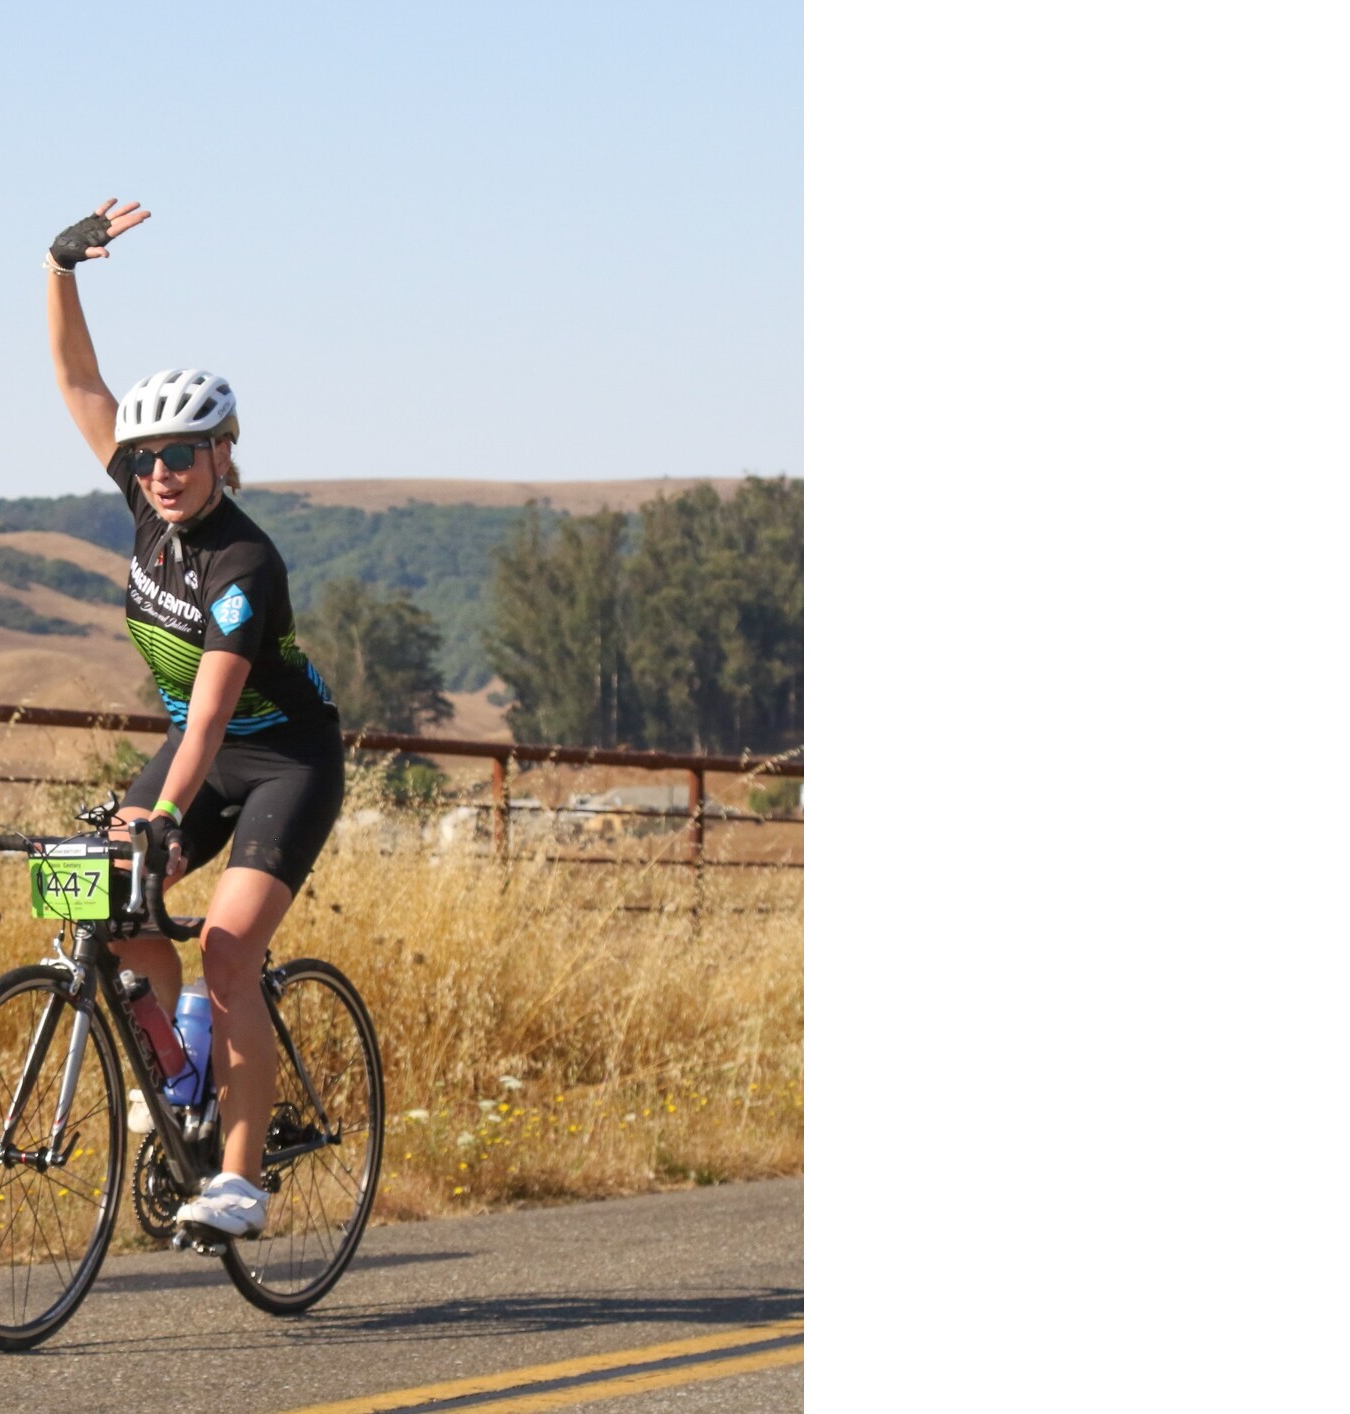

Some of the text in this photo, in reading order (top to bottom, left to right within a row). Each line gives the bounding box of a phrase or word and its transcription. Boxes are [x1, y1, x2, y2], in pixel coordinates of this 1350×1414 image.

[130, 555, 207, 623] MARIN CENTUR
[222, 595, 243, 609] 20
[219, 609, 240, 624] 23
